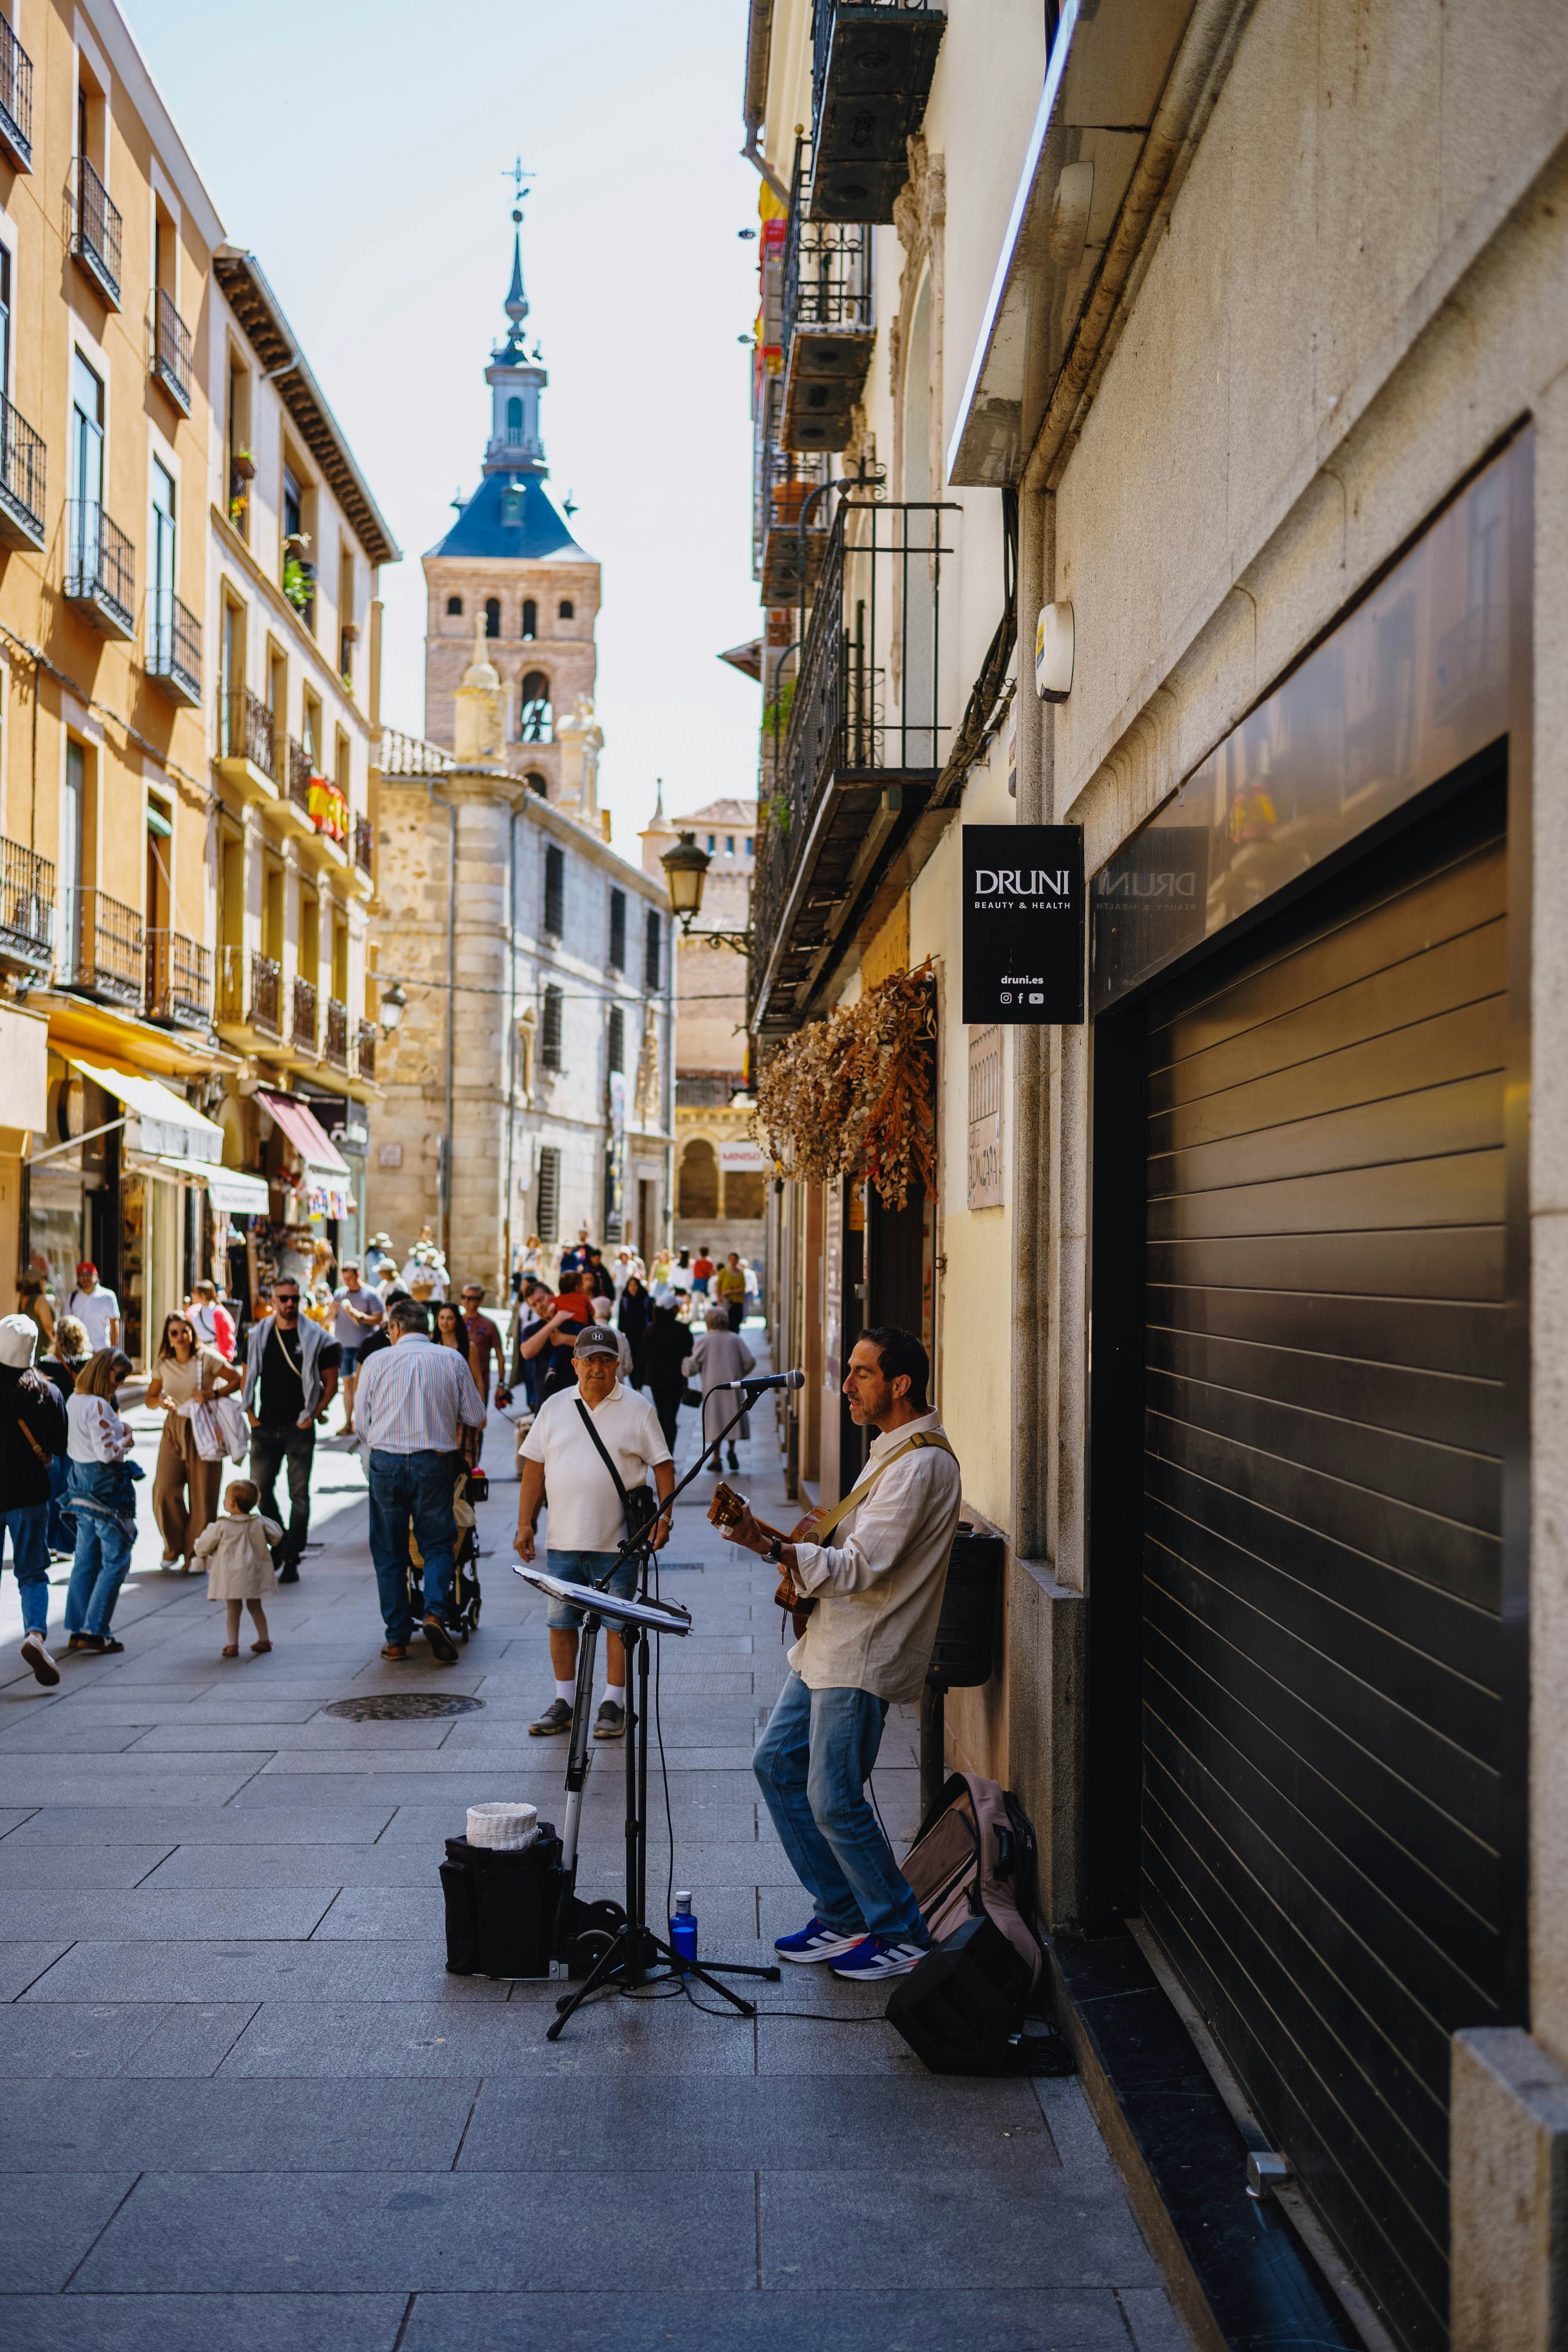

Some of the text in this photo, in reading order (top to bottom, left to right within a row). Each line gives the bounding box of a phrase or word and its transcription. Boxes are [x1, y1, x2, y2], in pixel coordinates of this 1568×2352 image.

[975, 870, 1070, 895] DRUNI
[1001, 975, 1044, 984] druni.es
[722, 1152, 760, 1160] MINISO
